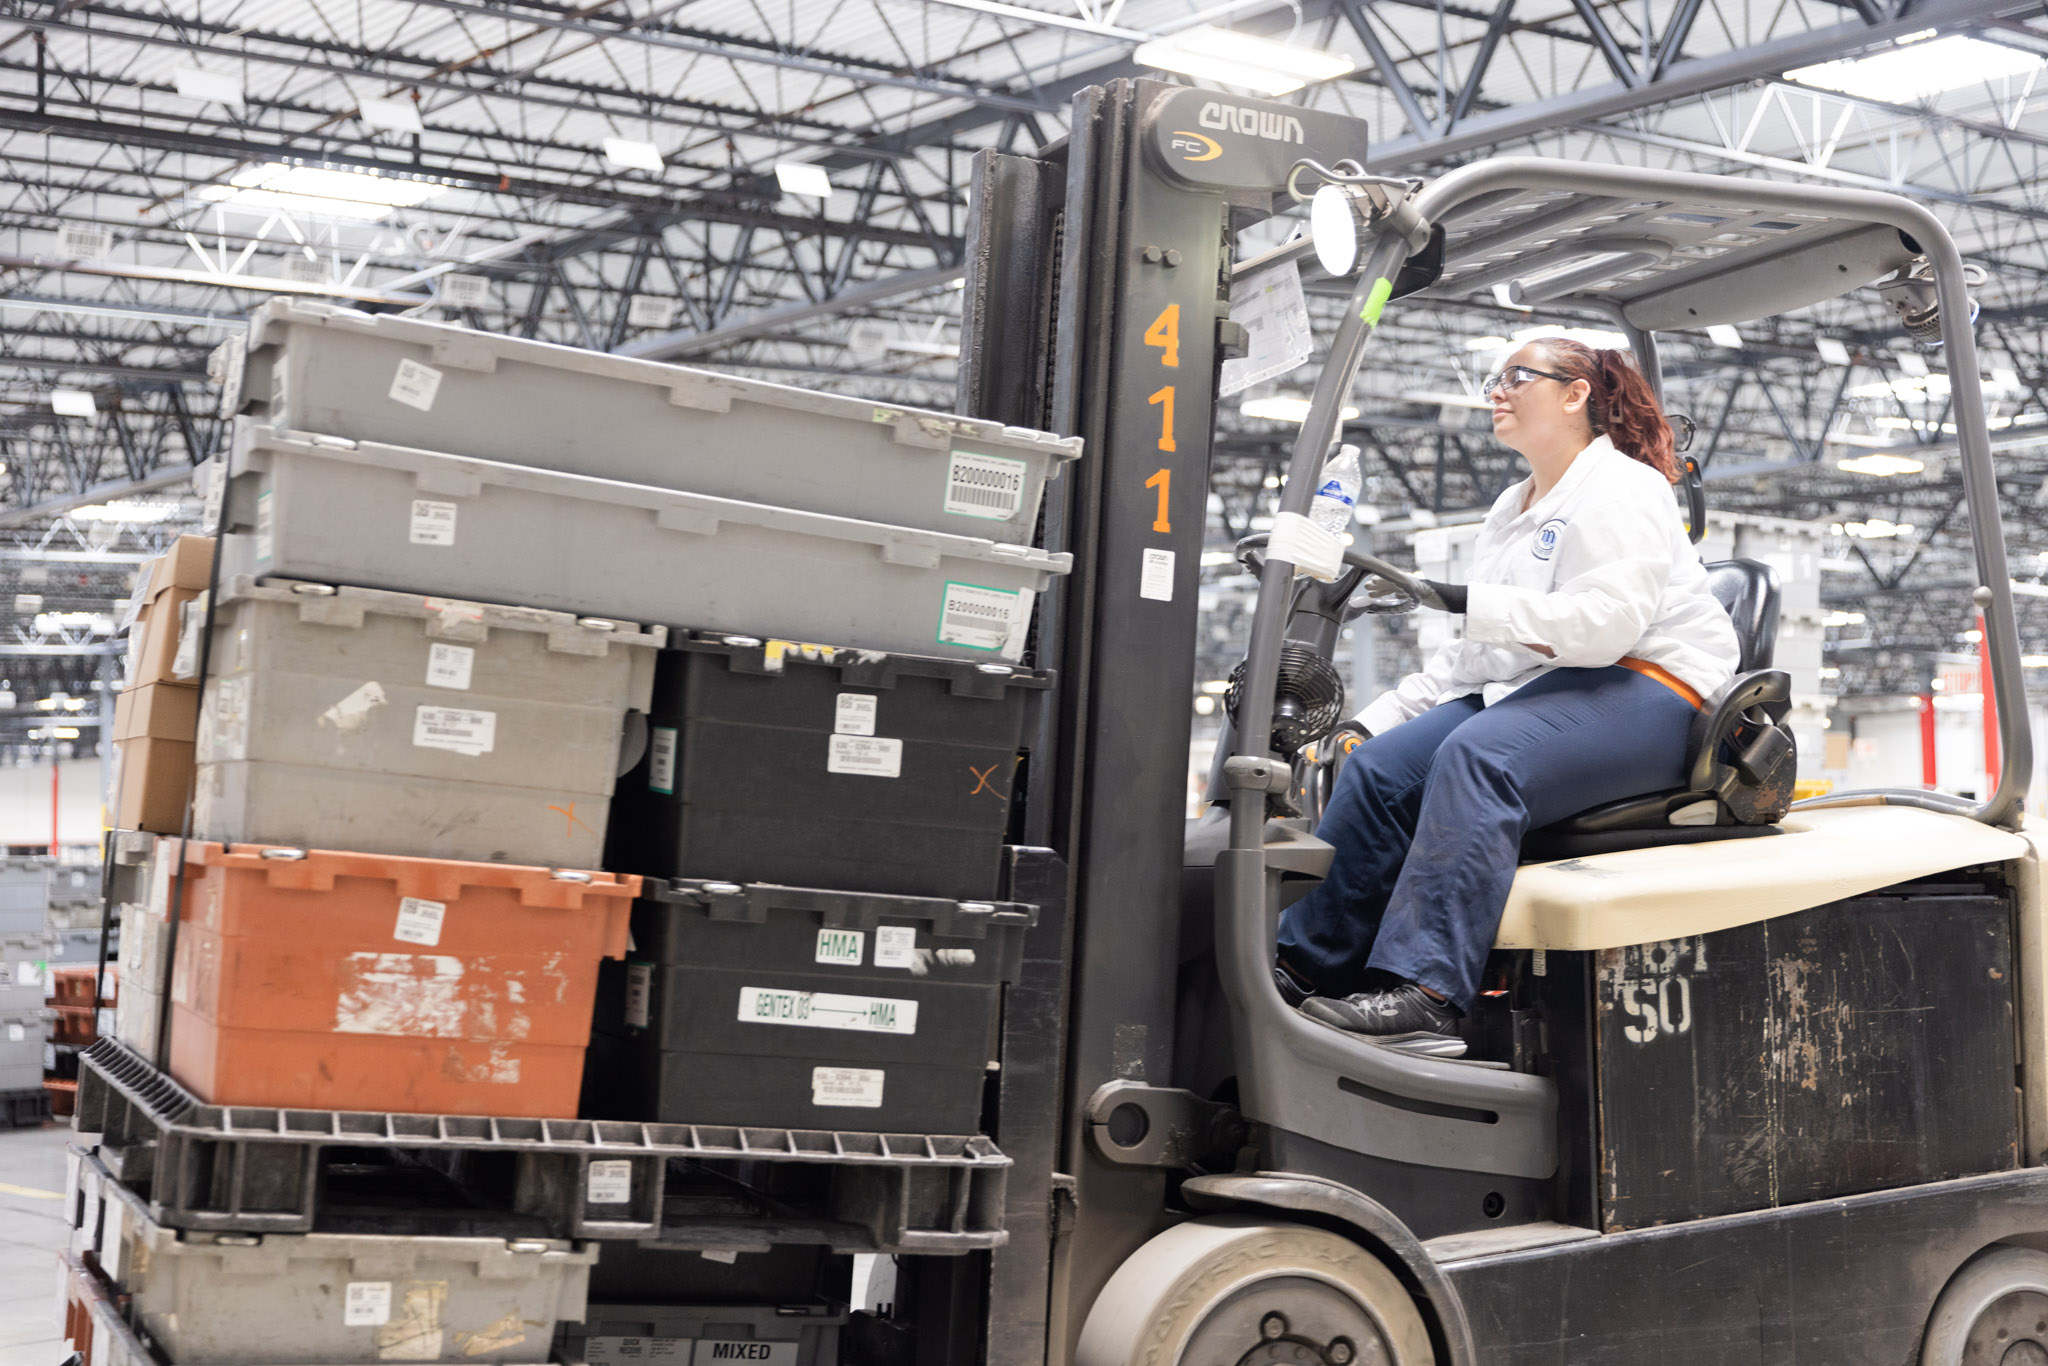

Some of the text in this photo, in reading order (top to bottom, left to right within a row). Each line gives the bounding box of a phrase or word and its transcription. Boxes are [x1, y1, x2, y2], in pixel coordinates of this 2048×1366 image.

[1198, 101, 1304, 145] CROWN
[1171, 139, 1201, 153] FC
[819, 933, 858, 959] HMA
[755, 993, 896, 1026] GENTEX 03 HMA
[713, 1342, 772, 1360] MIXED
